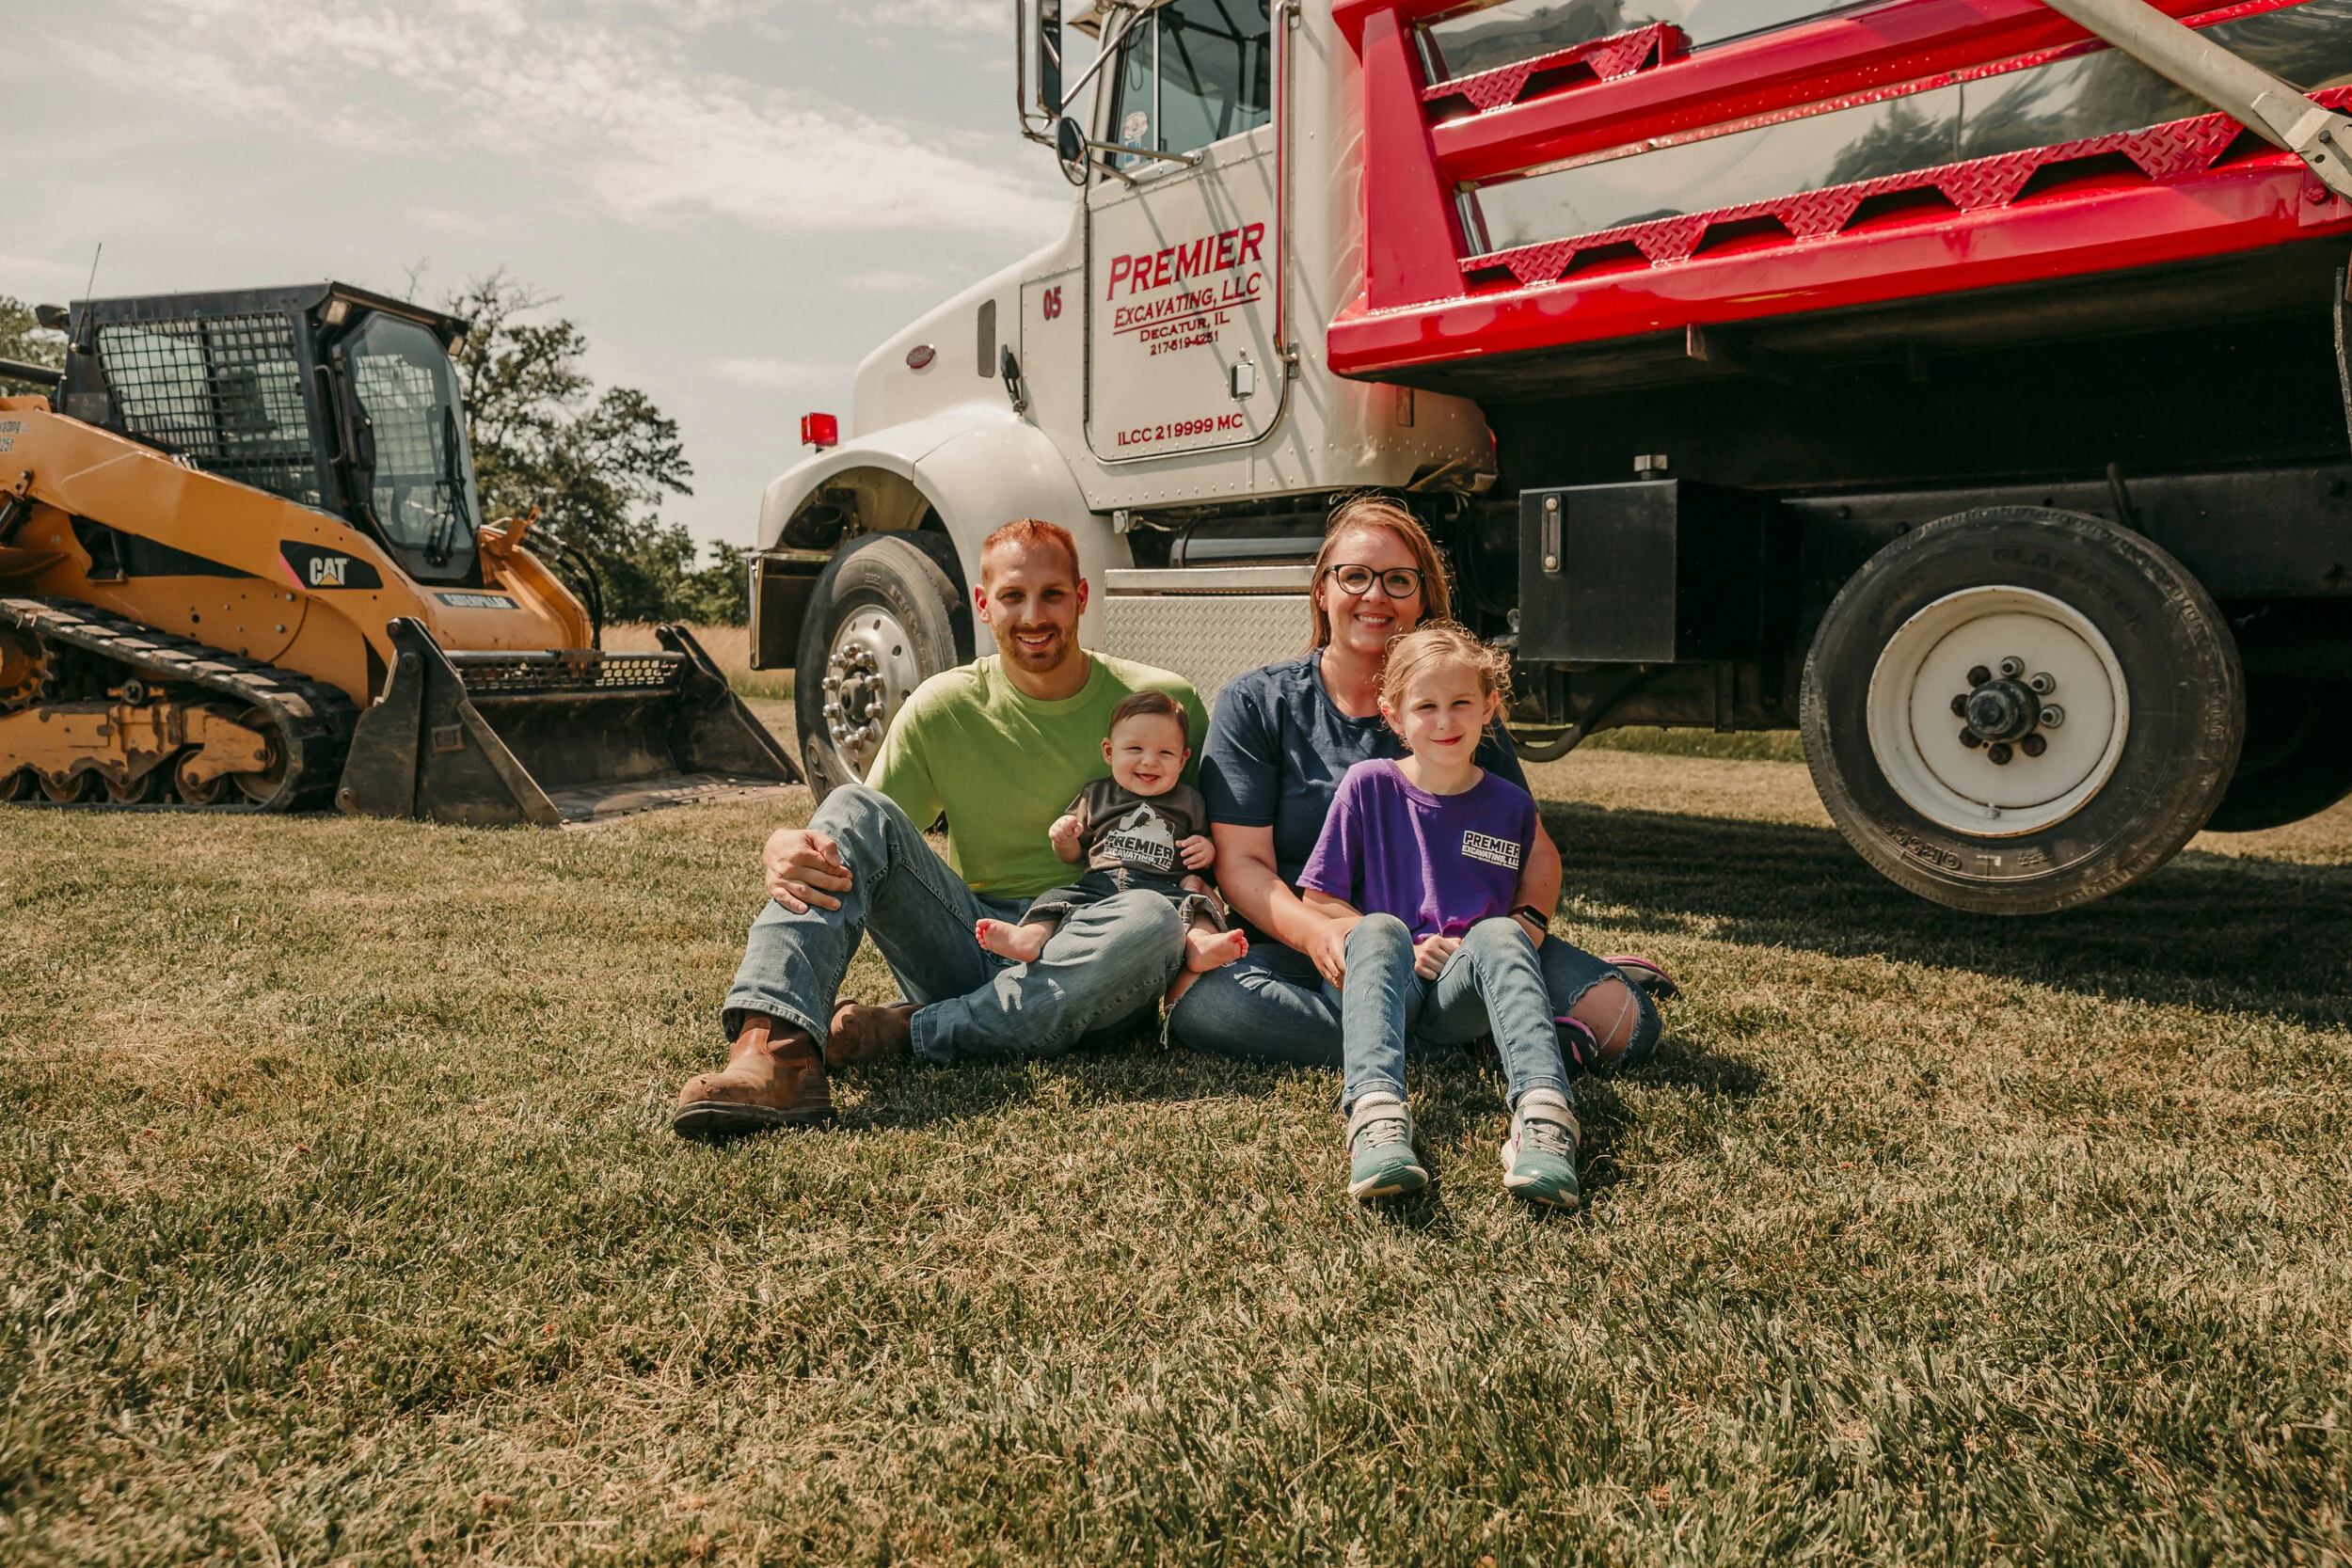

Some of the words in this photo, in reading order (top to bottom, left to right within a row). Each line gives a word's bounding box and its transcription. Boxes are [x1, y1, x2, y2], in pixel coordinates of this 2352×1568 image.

[1106, 222, 1265, 302] PREMIER
[1043, 286, 1062, 322] 05
[1114, 287, 1217, 329] EXCAVATING,
[1221, 272, 1262, 302] LLC
[1140, 317, 1211, 342] DECATUR,
[1215, 311, 1231, 325] IL
[1118, 427, 1152, 446] ILCC
[1154, 418, 1214, 441] 219999
[1217, 413, 1244, 432] MC
[309, 557, 348, 586] CAT
[1105, 834, 1174, 860] PREMIER
[1462, 845, 1507, 864] EXCAVATING,
[1464, 832, 1520, 857] PREMIER
[1157, 857, 1172, 870] LLC
